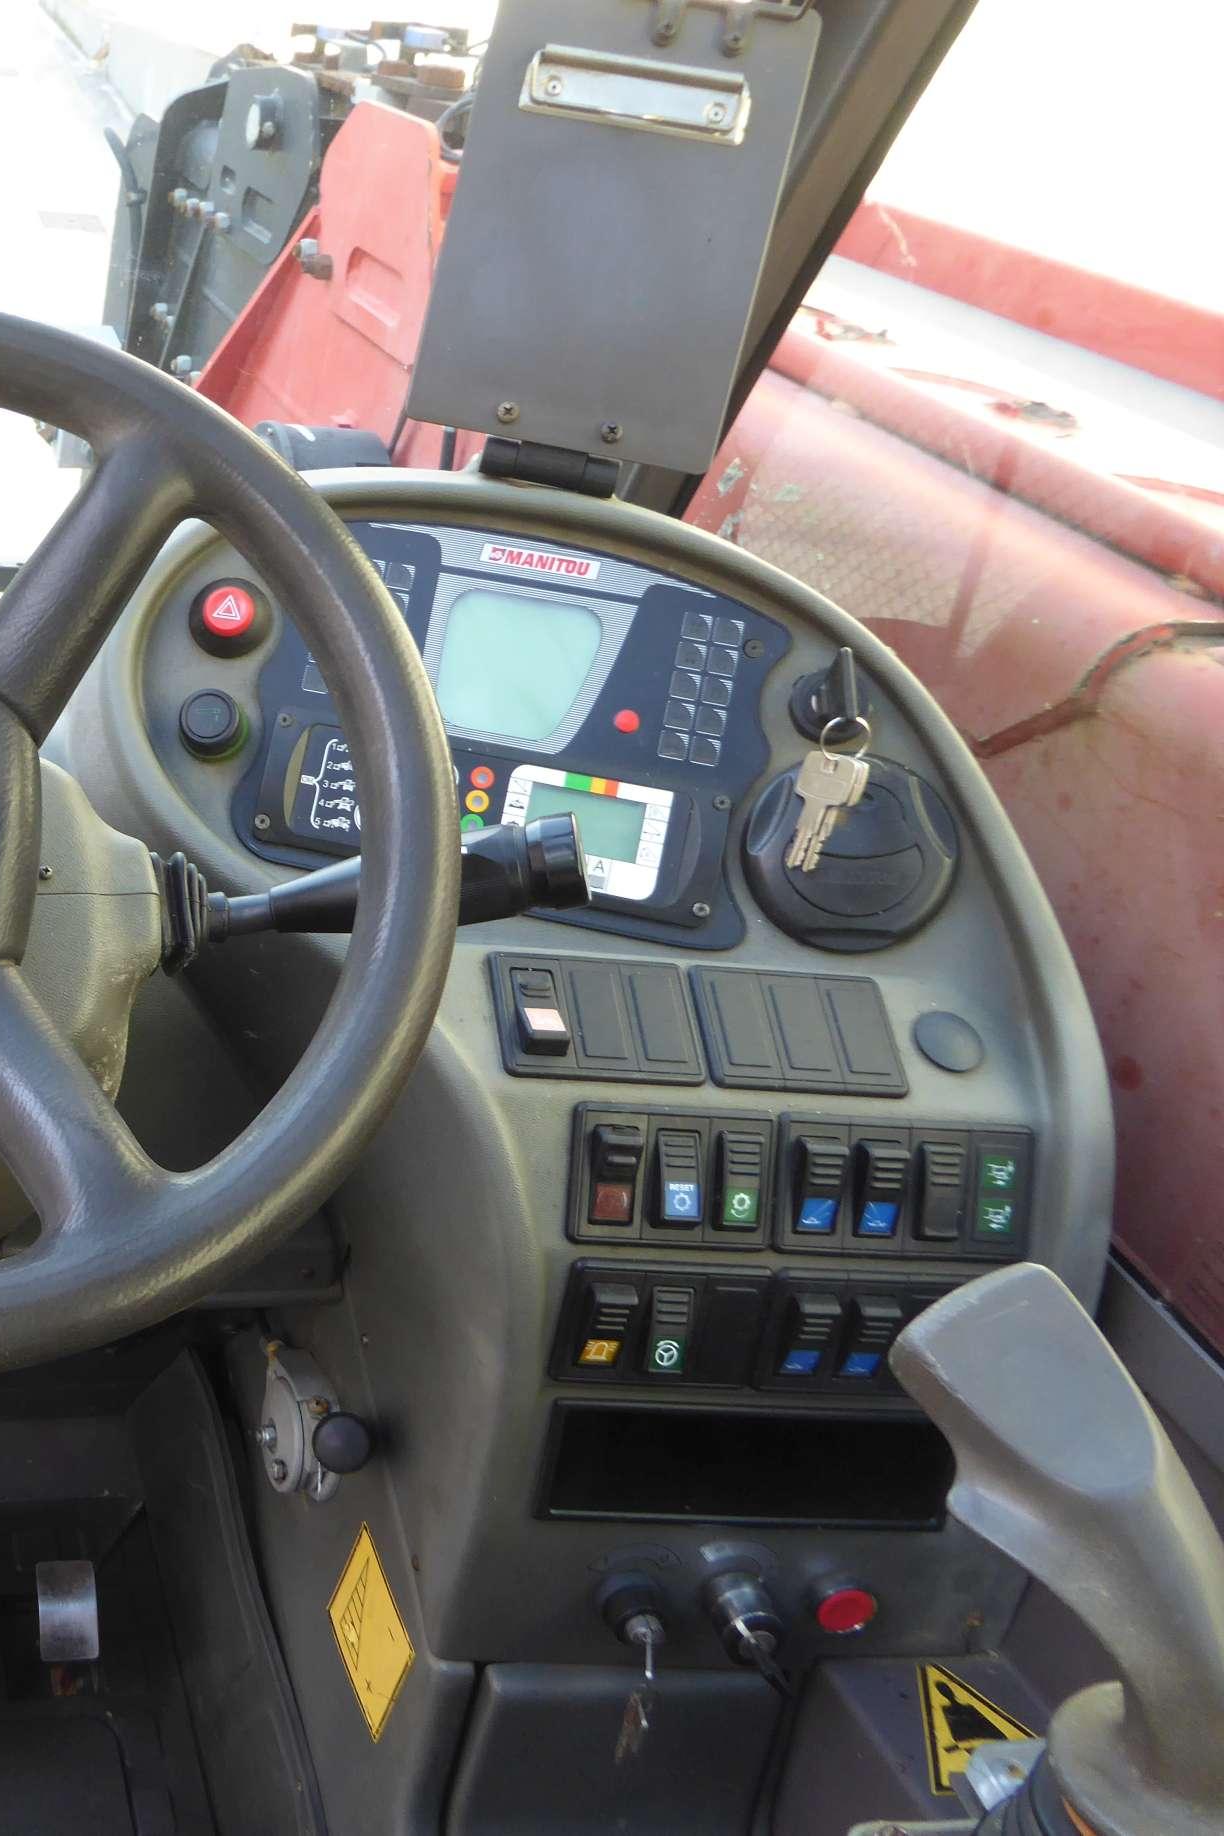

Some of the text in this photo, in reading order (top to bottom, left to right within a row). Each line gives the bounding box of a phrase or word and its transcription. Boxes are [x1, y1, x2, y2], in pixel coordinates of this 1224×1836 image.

[504, 549, 591, 576] MANITOU
[327, 761, 334, 770] 2
[322, 780, 329, 788] 3
[315, 817, 321, 826] 5
[593, 859, 605, 873] A
[669, 1183, 695, 1192] RESET
